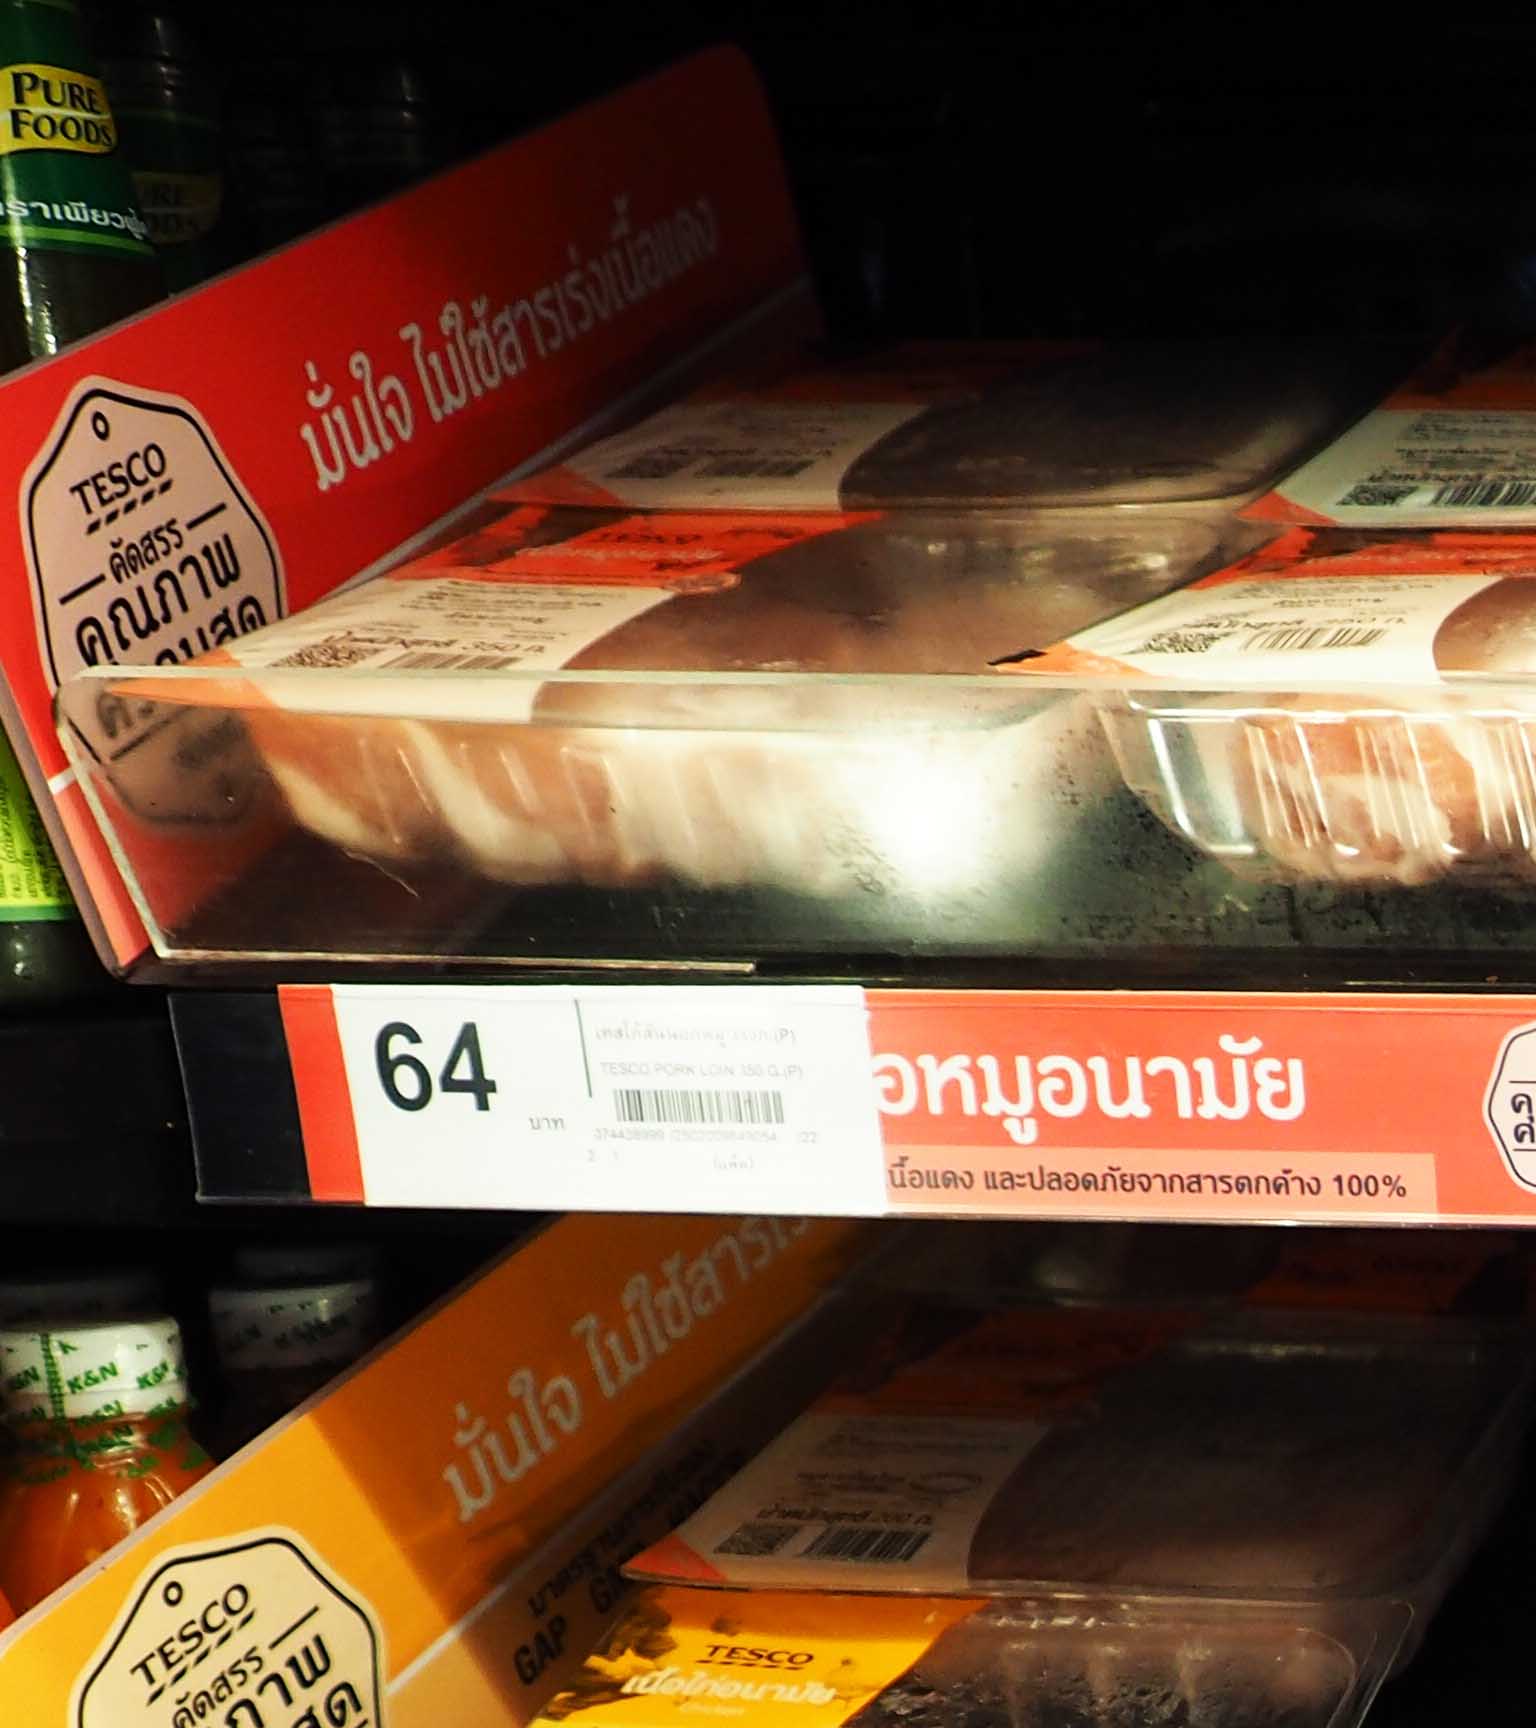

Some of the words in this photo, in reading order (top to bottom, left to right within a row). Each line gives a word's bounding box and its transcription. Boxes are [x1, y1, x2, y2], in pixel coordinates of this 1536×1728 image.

[12, 72, 101, 114] PURE
[10, 109, 112, 146] FOODS
[300, 349, 412, 492] มั่นใจ
[70, 444, 166, 515] TESCO
[110, 518, 183, 583] คัดสรร
[76, 533, 240, 666] คุณภาพ
[375, 1022, 497, 1112] 64
[600, 1062, 649, 1076] TESCO
[654, 1063, 696, 1077] PORK
[701, 1064, 734, 1077] LOIN
[985, 1165, 1321, 1197] และปลอดภัยจากสารตกค้าง
[1333, 1172, 1407, 1198] 100%
[67, 1362, 118, 1394] K&N
[443, 1368, 581, 1523] มั่นใจ
[131, 1584, 249, 1687] TESCO
[514, 1615, 569, 1686] GAP
[706, 1644, 814, 1666] TESCO
